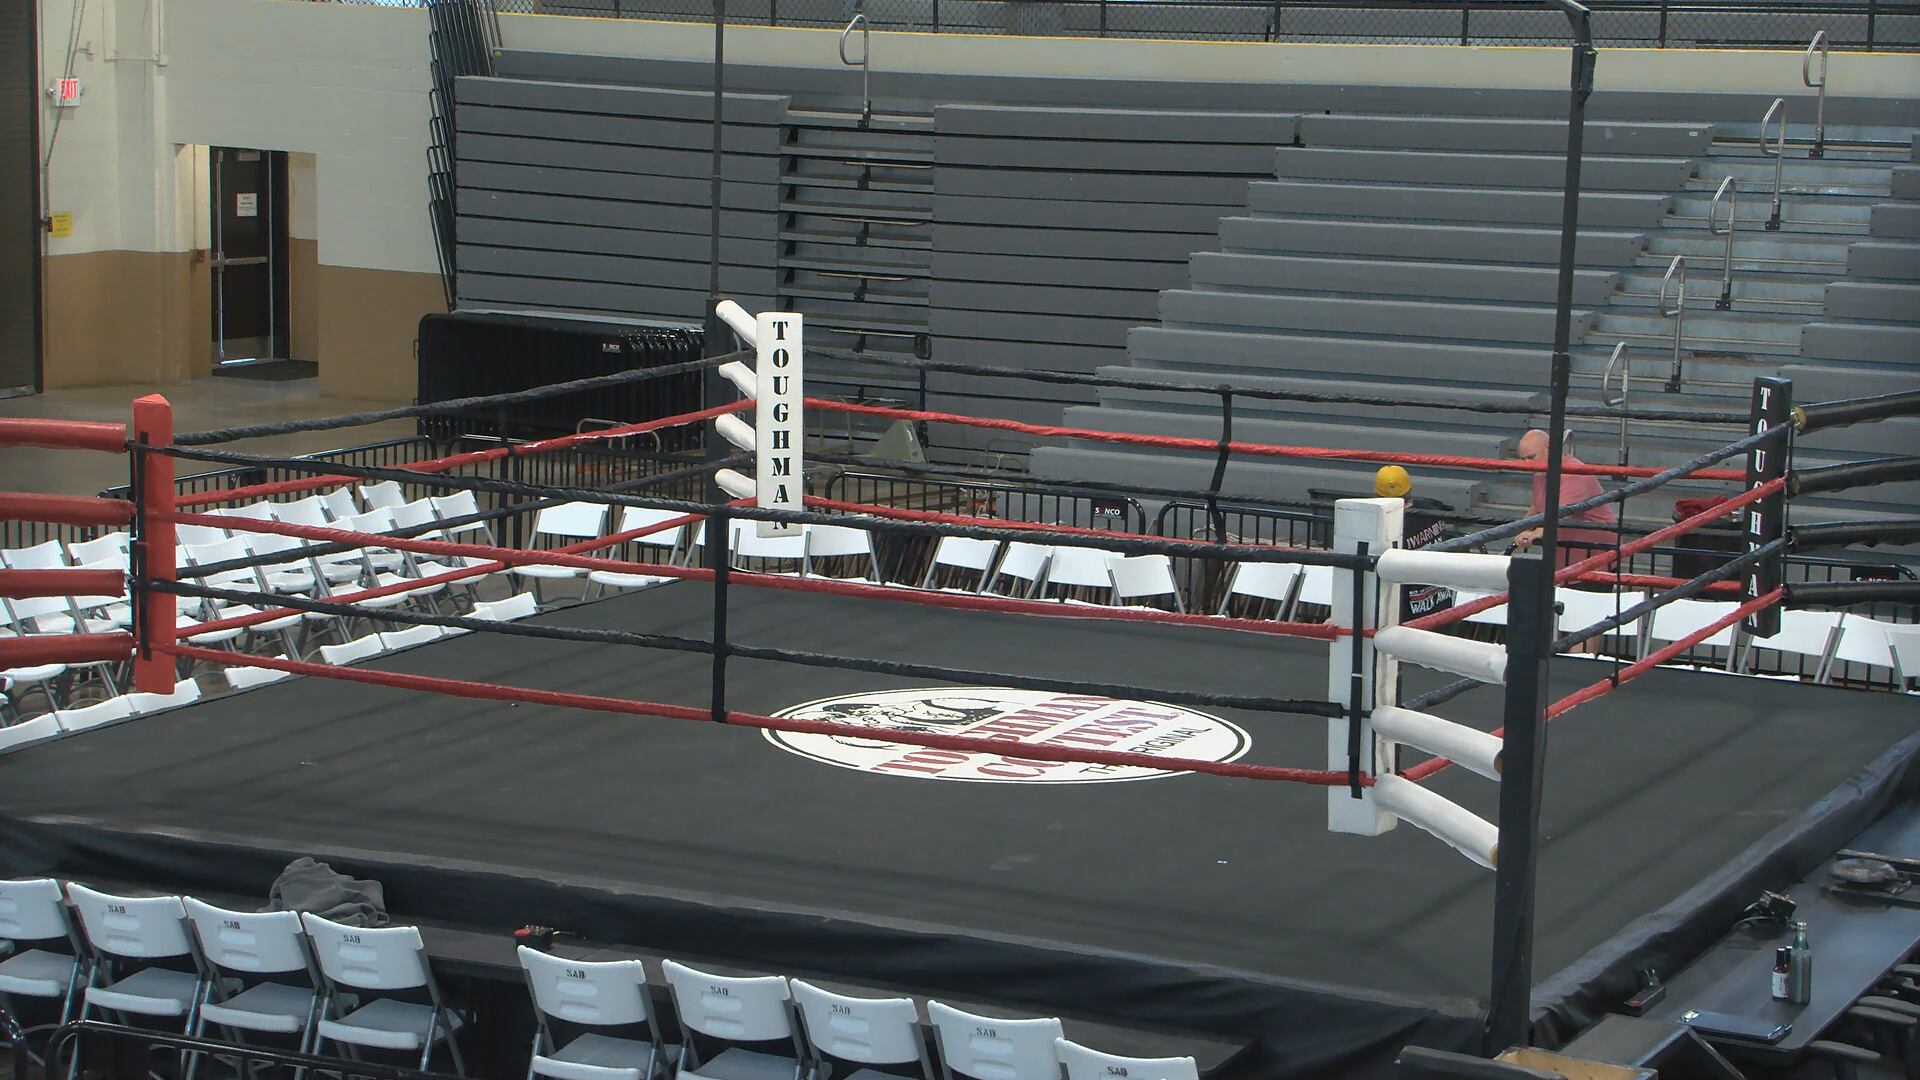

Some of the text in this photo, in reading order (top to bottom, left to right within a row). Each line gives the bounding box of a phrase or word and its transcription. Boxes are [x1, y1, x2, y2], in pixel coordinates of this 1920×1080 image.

[61, 80, 77, 98] EXIT
[977, 707, 1179, 777] COTEST
[1128, 727, 1212, 754] RIGINAL
